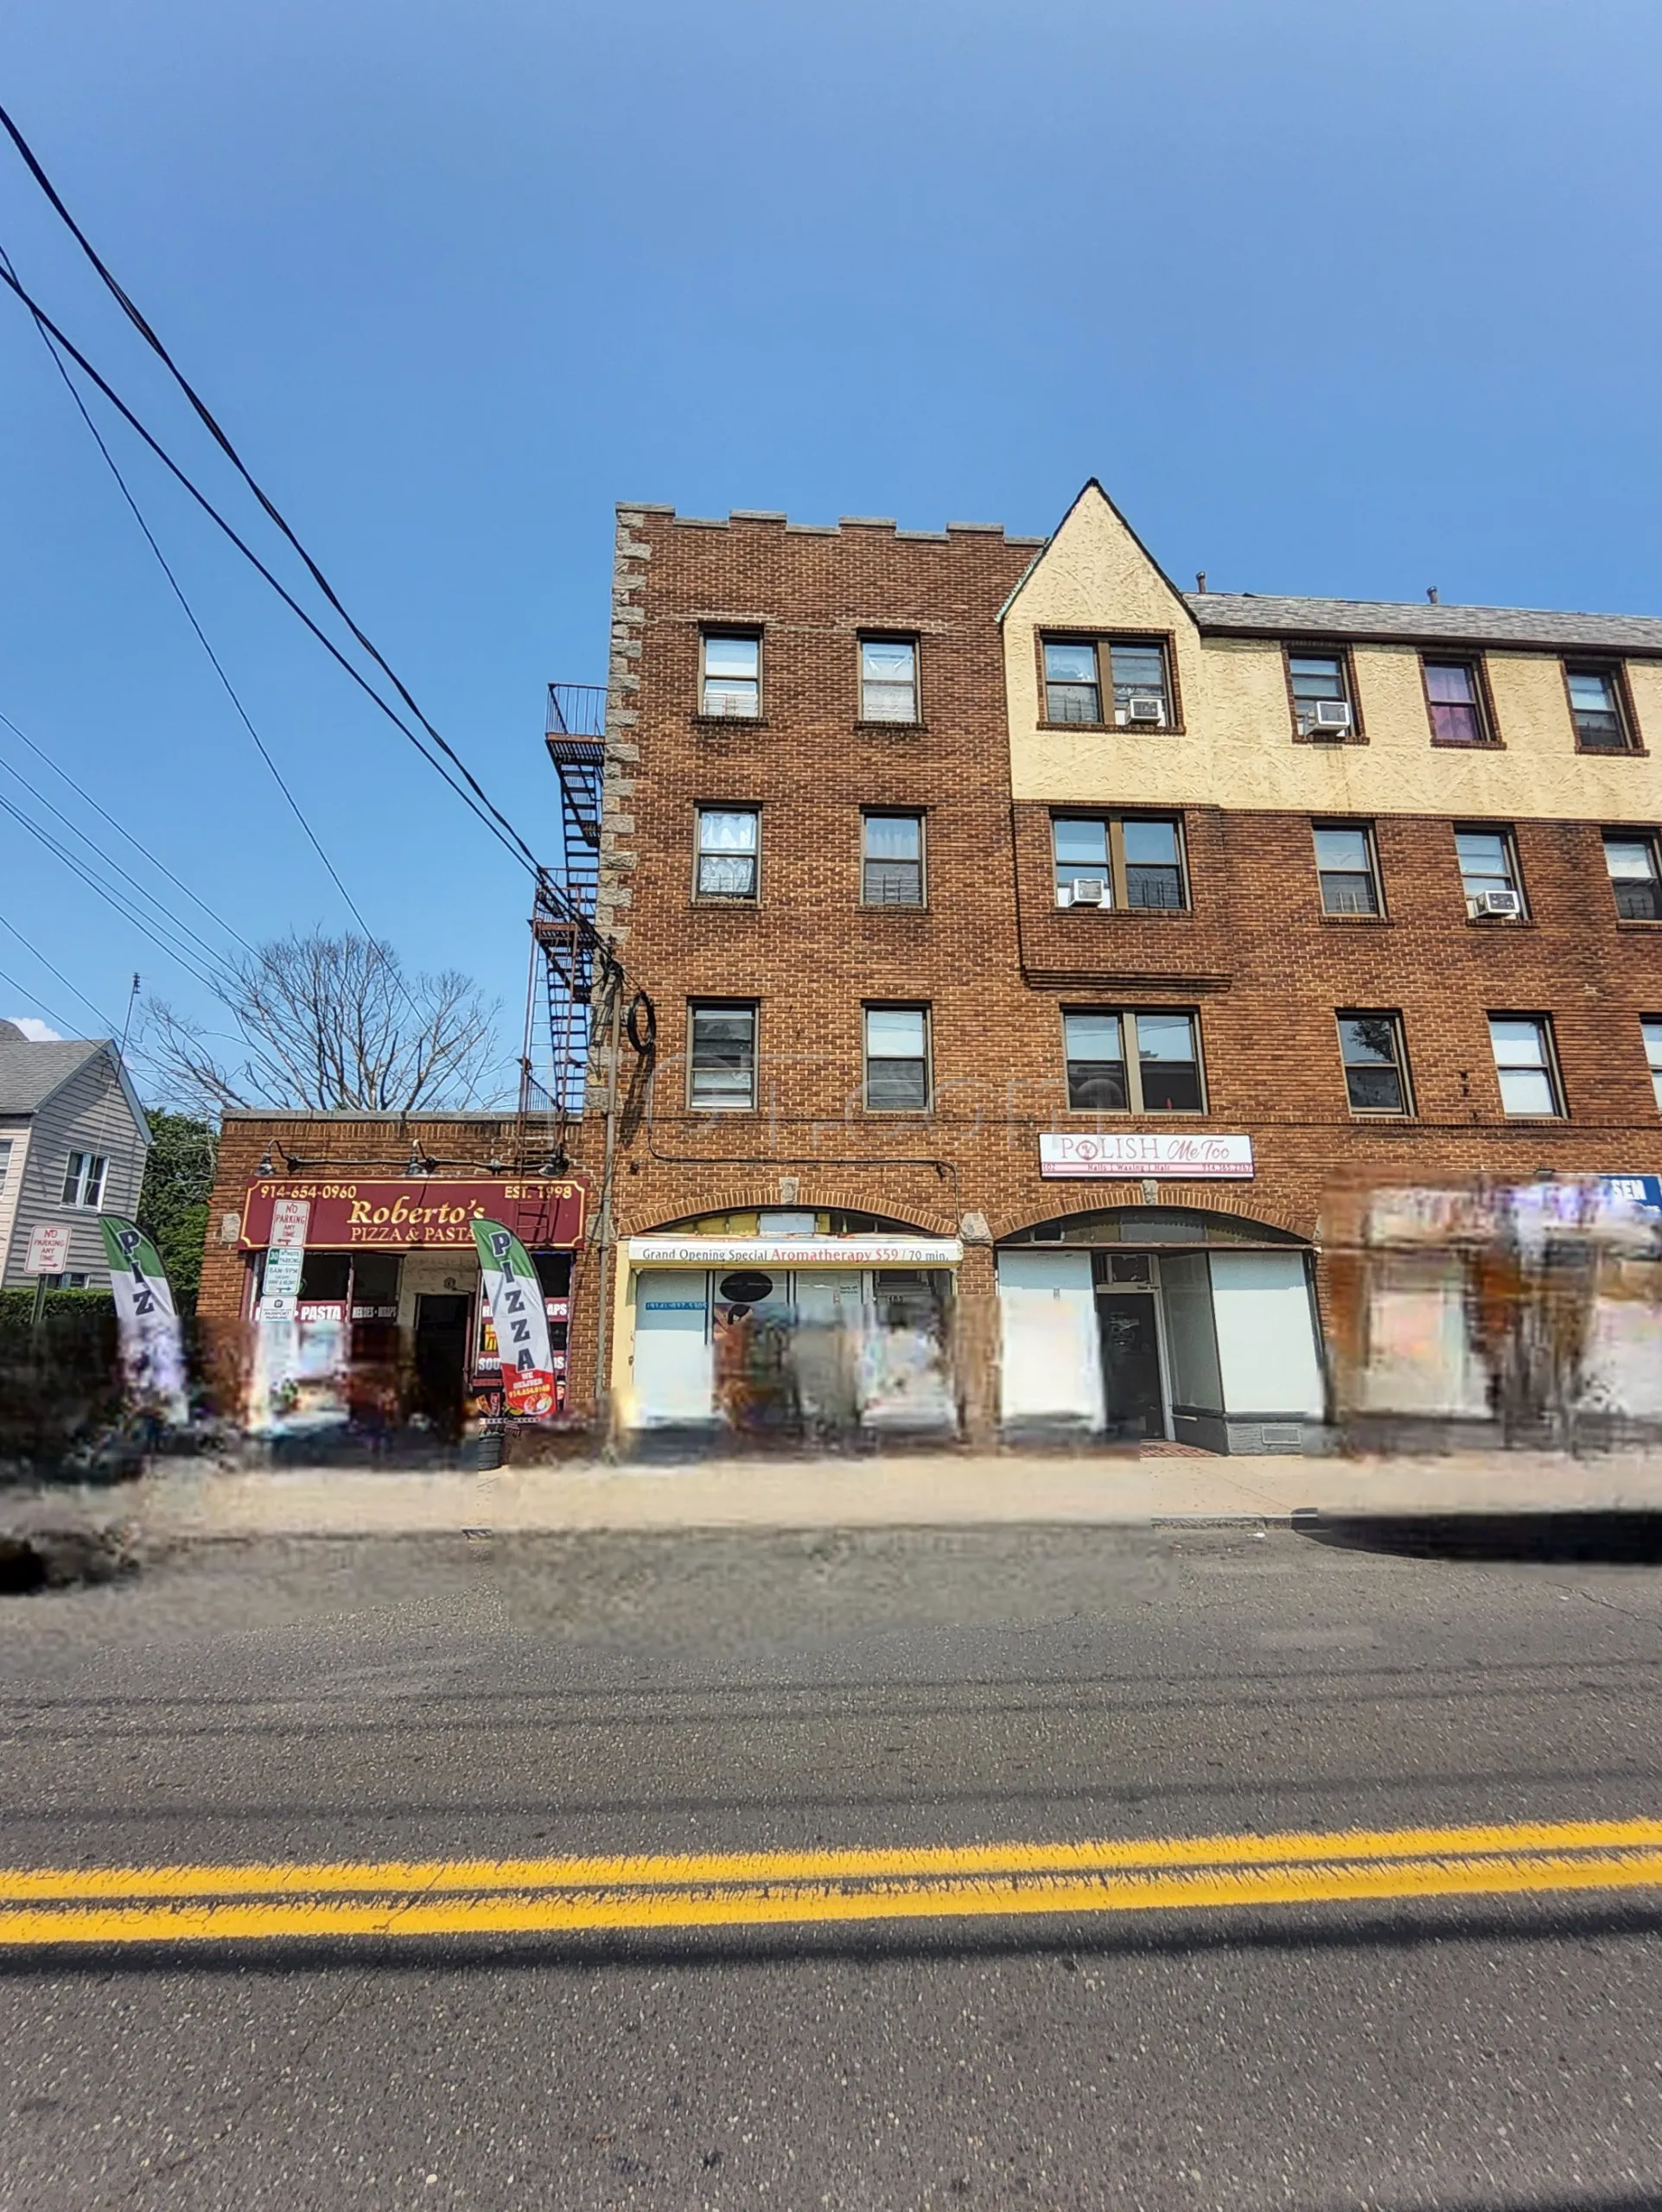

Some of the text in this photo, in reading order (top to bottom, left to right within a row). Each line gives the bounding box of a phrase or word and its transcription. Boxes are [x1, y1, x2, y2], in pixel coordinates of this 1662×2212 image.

[1060, 1137, 1230, 1160] POLISH Me Too
[260, 1185, 356, 1198] 914-654-0960
[505, 1185, 572, 1198] EST. 1998
[286, 1204, 298, 1214] NO
[347, 1196, 485, 1224] Roberto's
[276, 1215, 305, 1224] PARKING
[44, 1230, 58, 1239] NO
[351, 1227, 401, 1242] PIZZA
[405, 1228, 420, 1242] &
[34, 1239, 65, 1248] PARKING
[643, 1249, 676, 1260] Grand
[679, 1249, 725, 1262] Opening
[729, 1249, 767, 1262] Special
[771, 1249, 871, 1263] Aromatherapy
[876, 1249, 899, 1262] $59
[909, 1250, 922, 1262] 70
[926, 1252, 949, 1262] min.
[490, 1233, 536, 1372] PIZZA
[301, 1306, 341, 1320] PASTA
